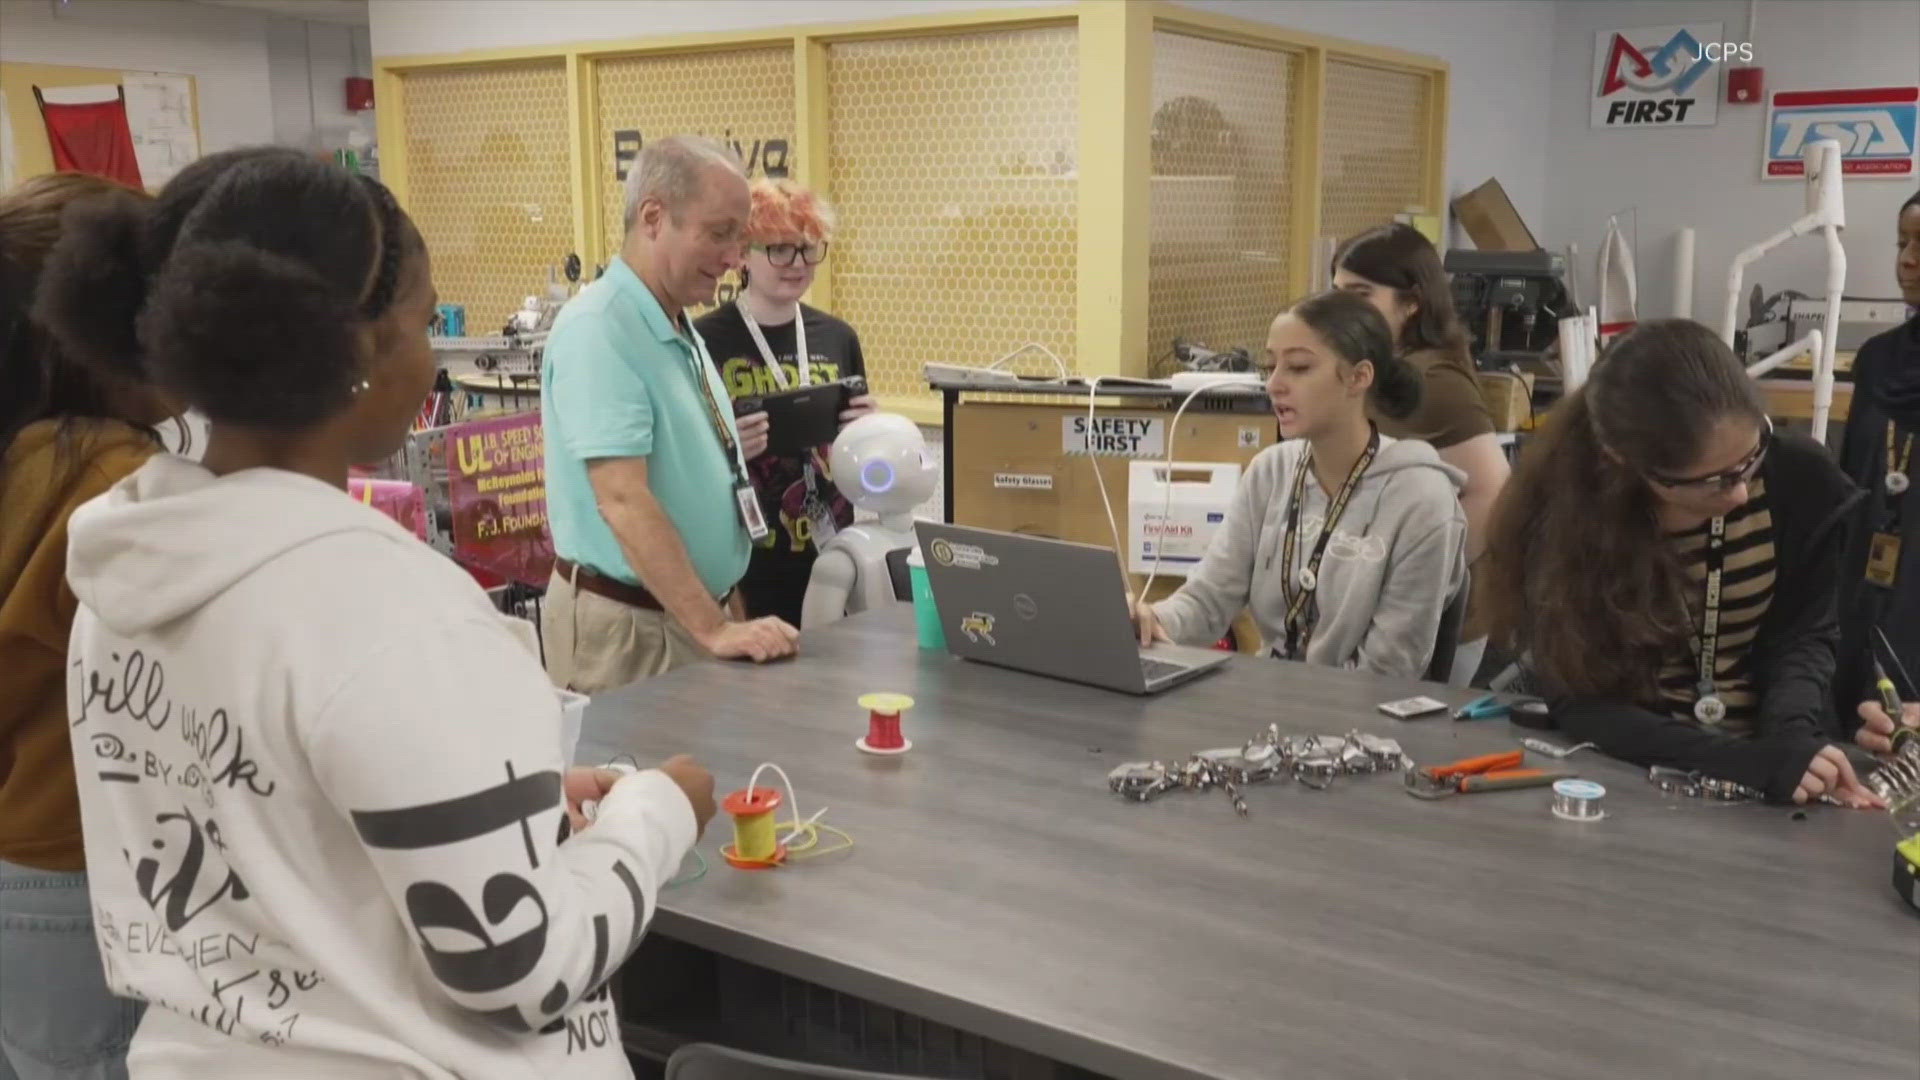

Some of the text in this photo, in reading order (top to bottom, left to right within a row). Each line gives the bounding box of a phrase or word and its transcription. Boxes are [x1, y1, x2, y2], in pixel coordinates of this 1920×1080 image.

[1606, 98, 1696, 124] FIRST
[1775, 110, 1912, 156] TSA
[723, 357, 839, 398] GHOST
[501, 427, 531, 447] SPEED
[1074, 417, 1152, 436] SAFETY
[1085, 435, 1142, 452] FIRST
[477, 470, 537, 493] McReynolds
[995, 475, 1052, 485] Safety Glasses
[1143, 524, 1193, 535] First Aid Kit
[144, 750, 173, 786] BY
